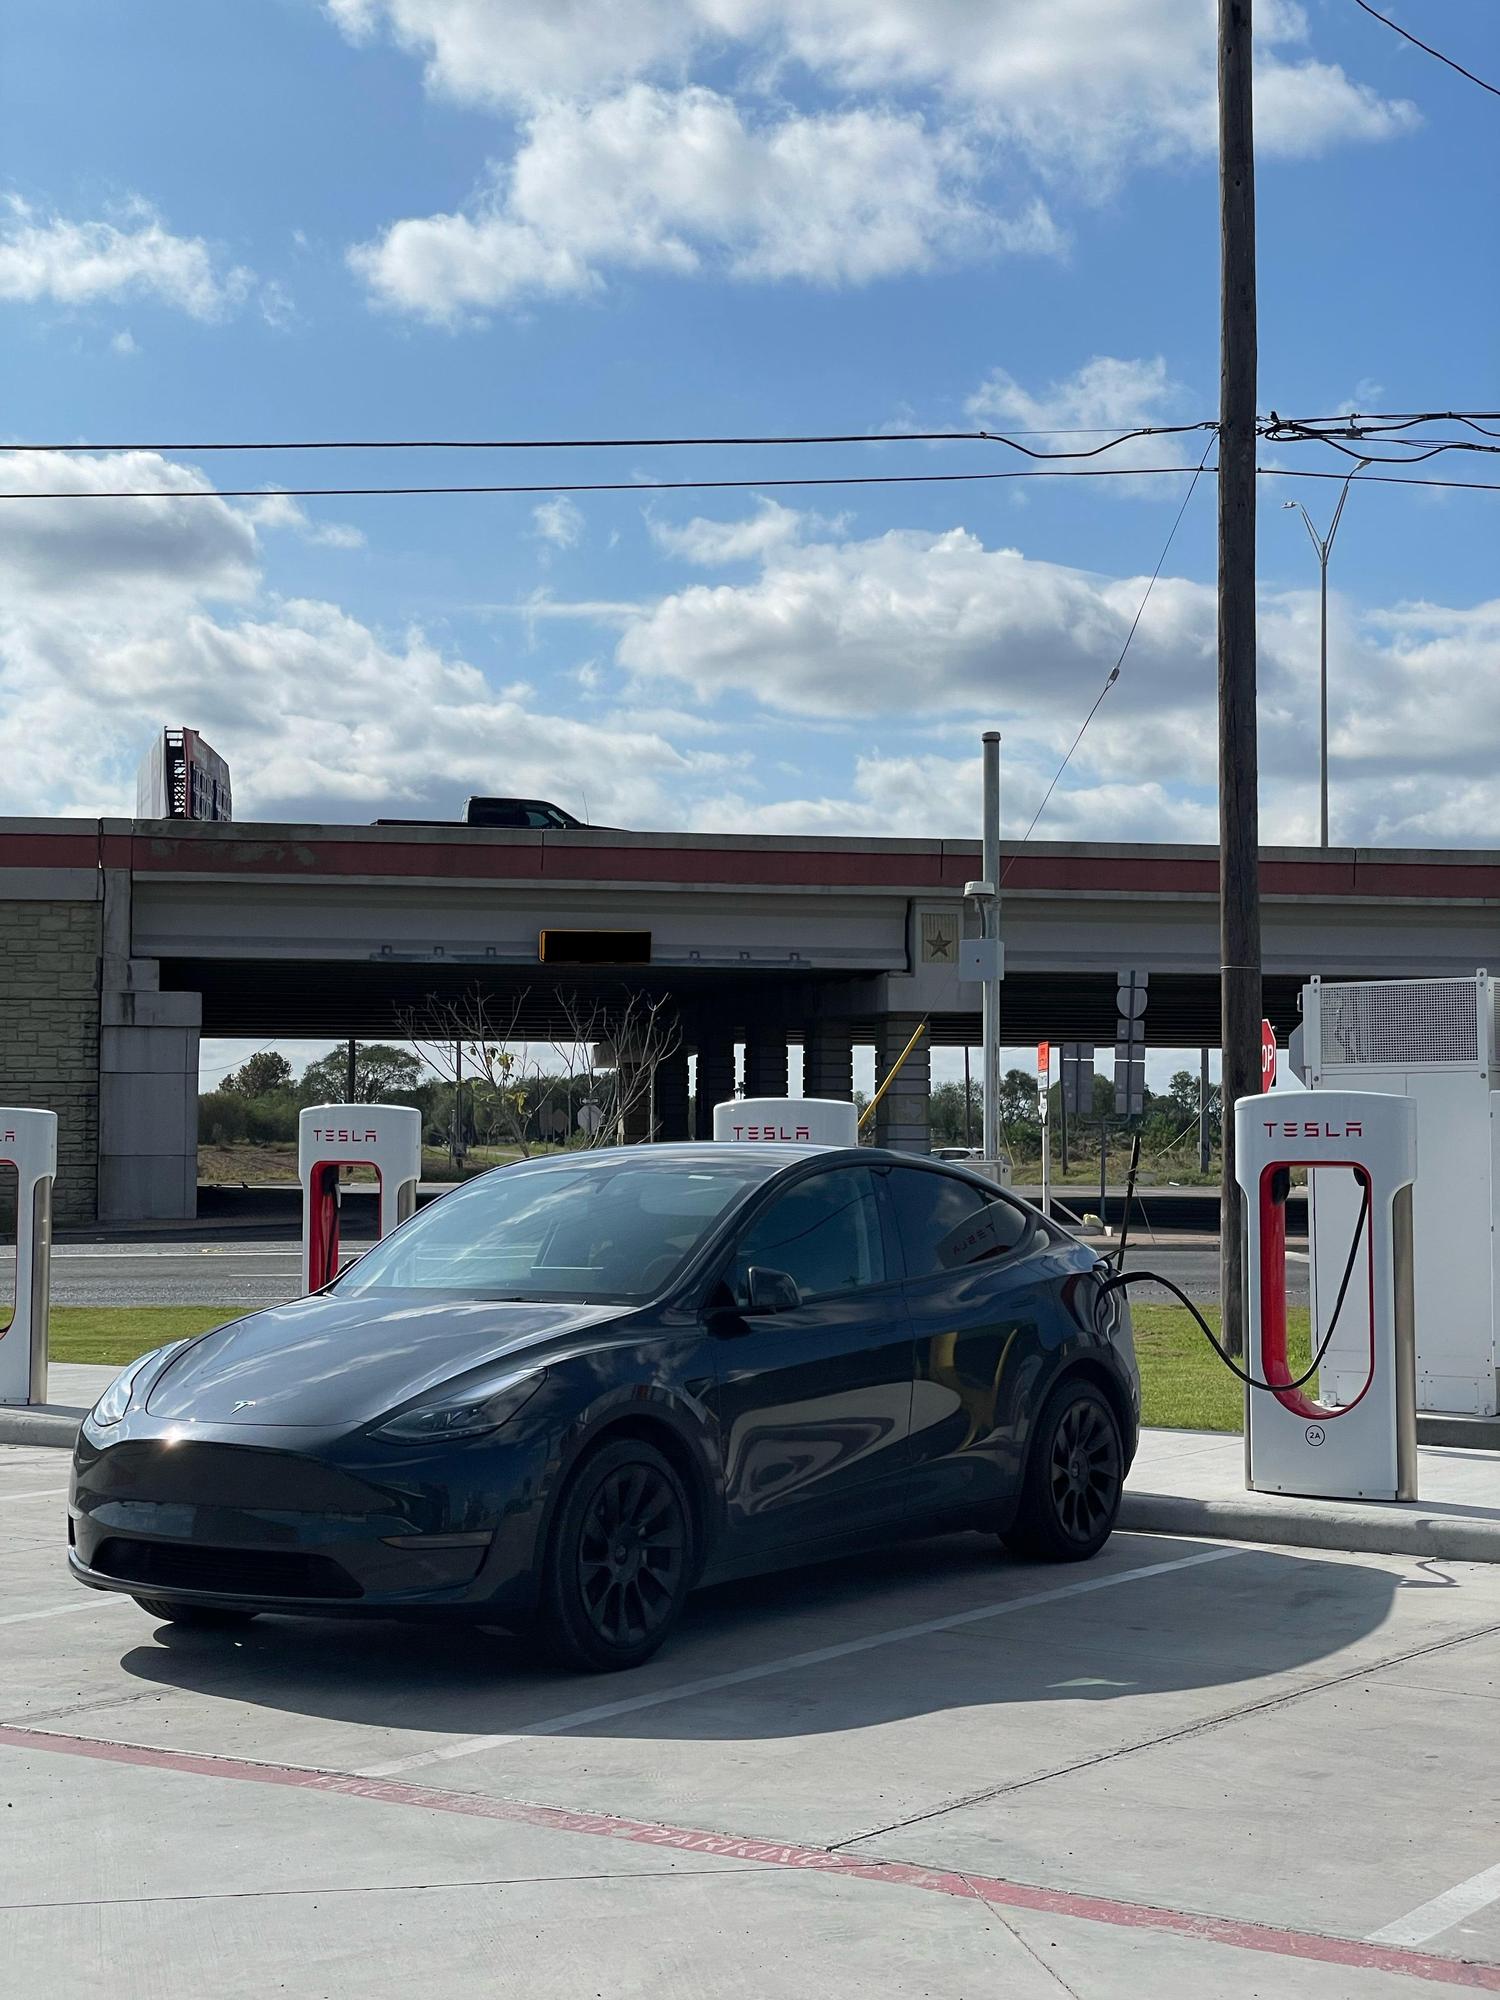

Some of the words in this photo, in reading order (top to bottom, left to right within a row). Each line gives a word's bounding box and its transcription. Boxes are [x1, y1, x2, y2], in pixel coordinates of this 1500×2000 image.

[1262, 1044, 1274, 1073] OP
[313, 1130, 377, 1142] TESLA
[733, 1126, 809, 1140] TESLA
[1263, 1122, 1362, 1138] TESLA
[1309, 1431, 1321, 1440] 2A
